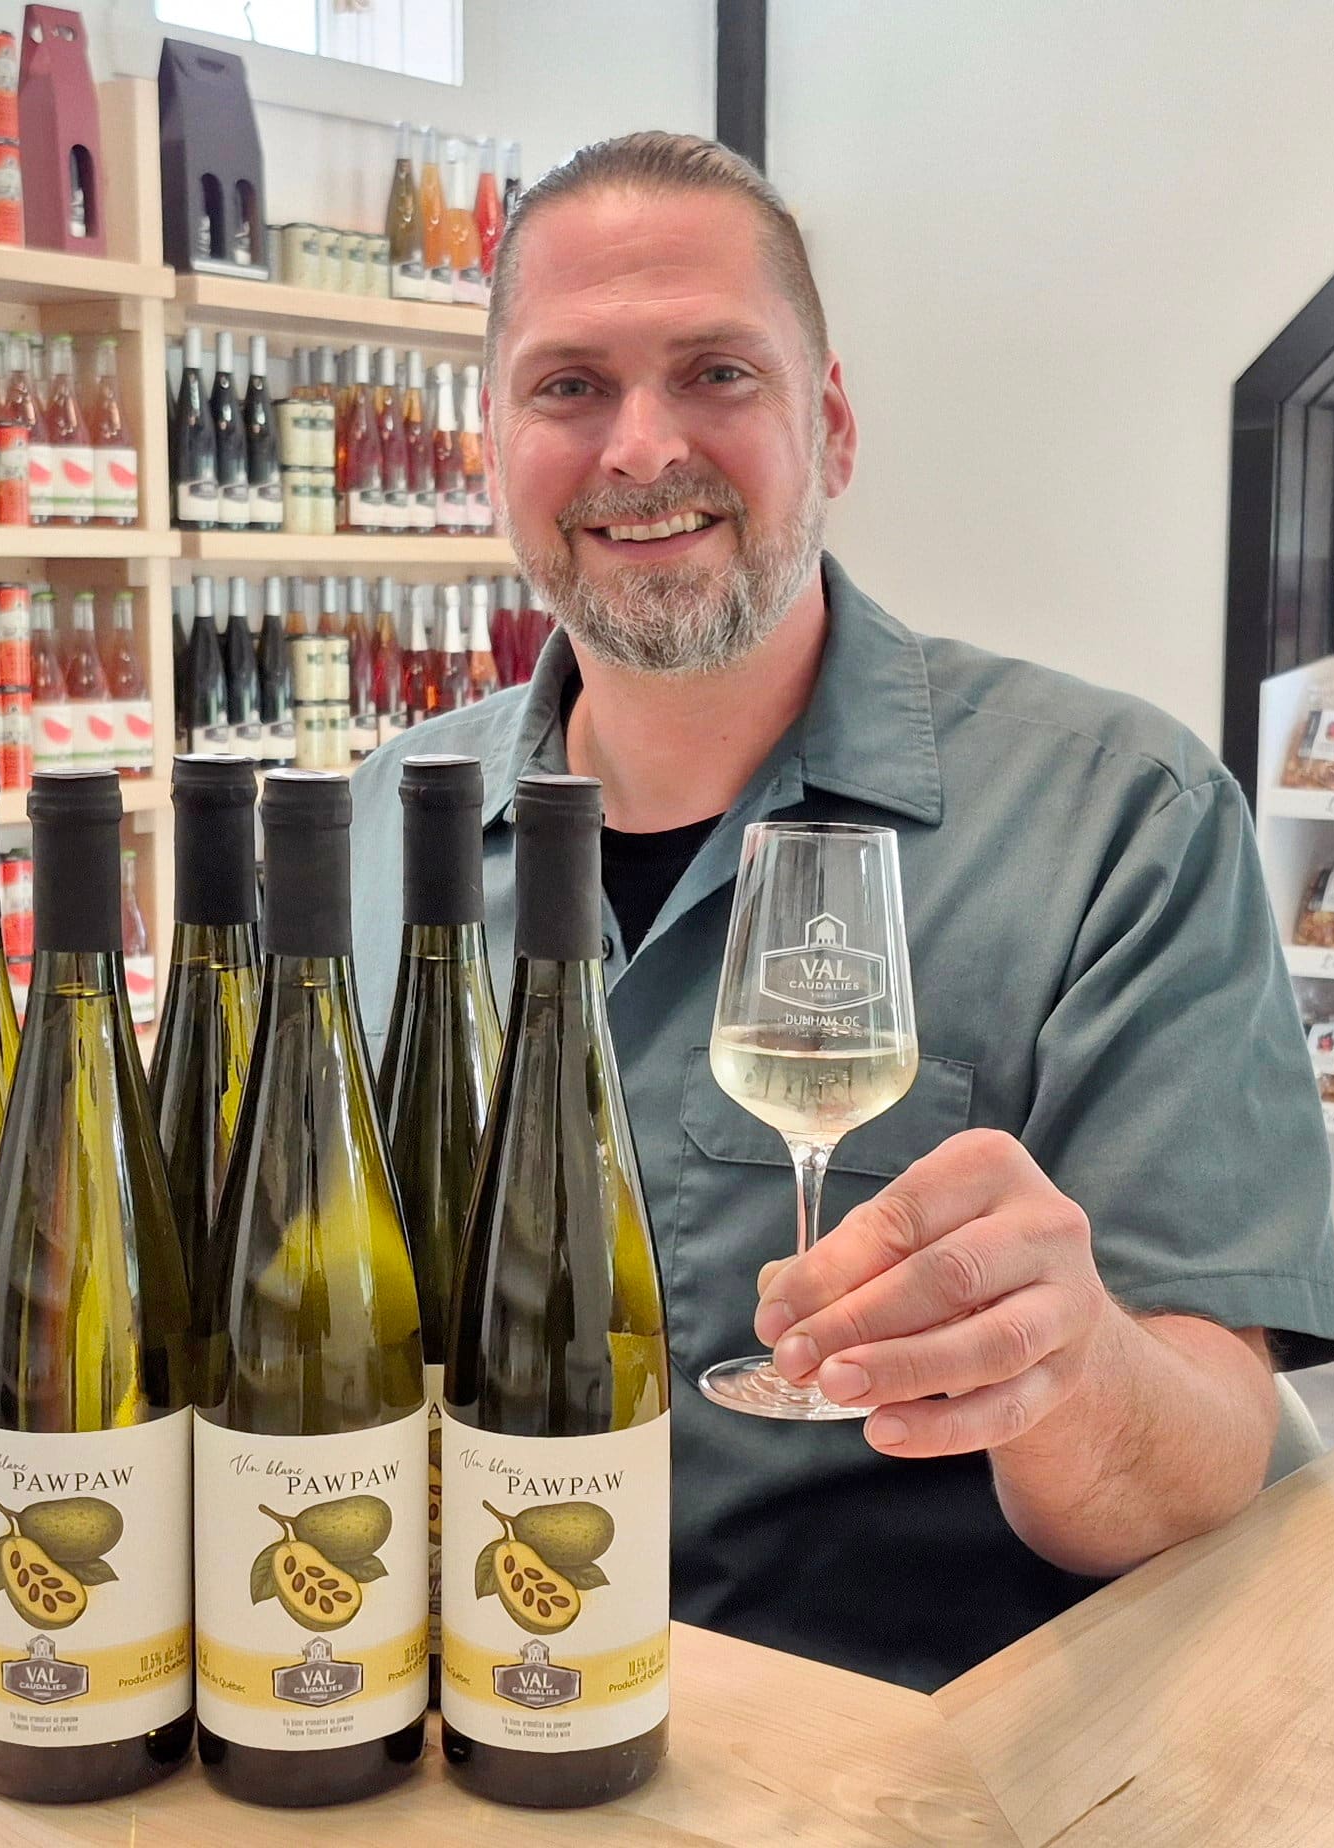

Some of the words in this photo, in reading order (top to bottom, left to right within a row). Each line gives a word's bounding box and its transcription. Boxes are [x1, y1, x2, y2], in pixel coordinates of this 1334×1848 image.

[799, 958, 851, 981] VAL
[788, 980, 860, 991] CAUDALIES
[229, 1454, 261, 1476] Vin
[266, 1460, 305, 1477] blanc
[457, 1449, 483, 1469] Vin
[488, 1457, 524, 1476] blanc
[12, 1465, 135, 1492] PAWPAW
[286, 1459, 402, 1496] PAWPAW
[506, 1470, 625, 1497] PAWPAW
[25, 1667, 60, 1684] VAL
[118, 1672, 152, 1687] Product
[154, 1667, 162, 1678] of
[300, 1669, 337, 1686] VAL
[518, 1671, 553, 1689] VAL
[19, 1682, 68, 1691] CAUDALIES
[293, 1685, 344, 1695] CAUDALIES
[512, 1687, 561, 1696] CAUDALIES
[609, 1677, 638, 1694] Product
